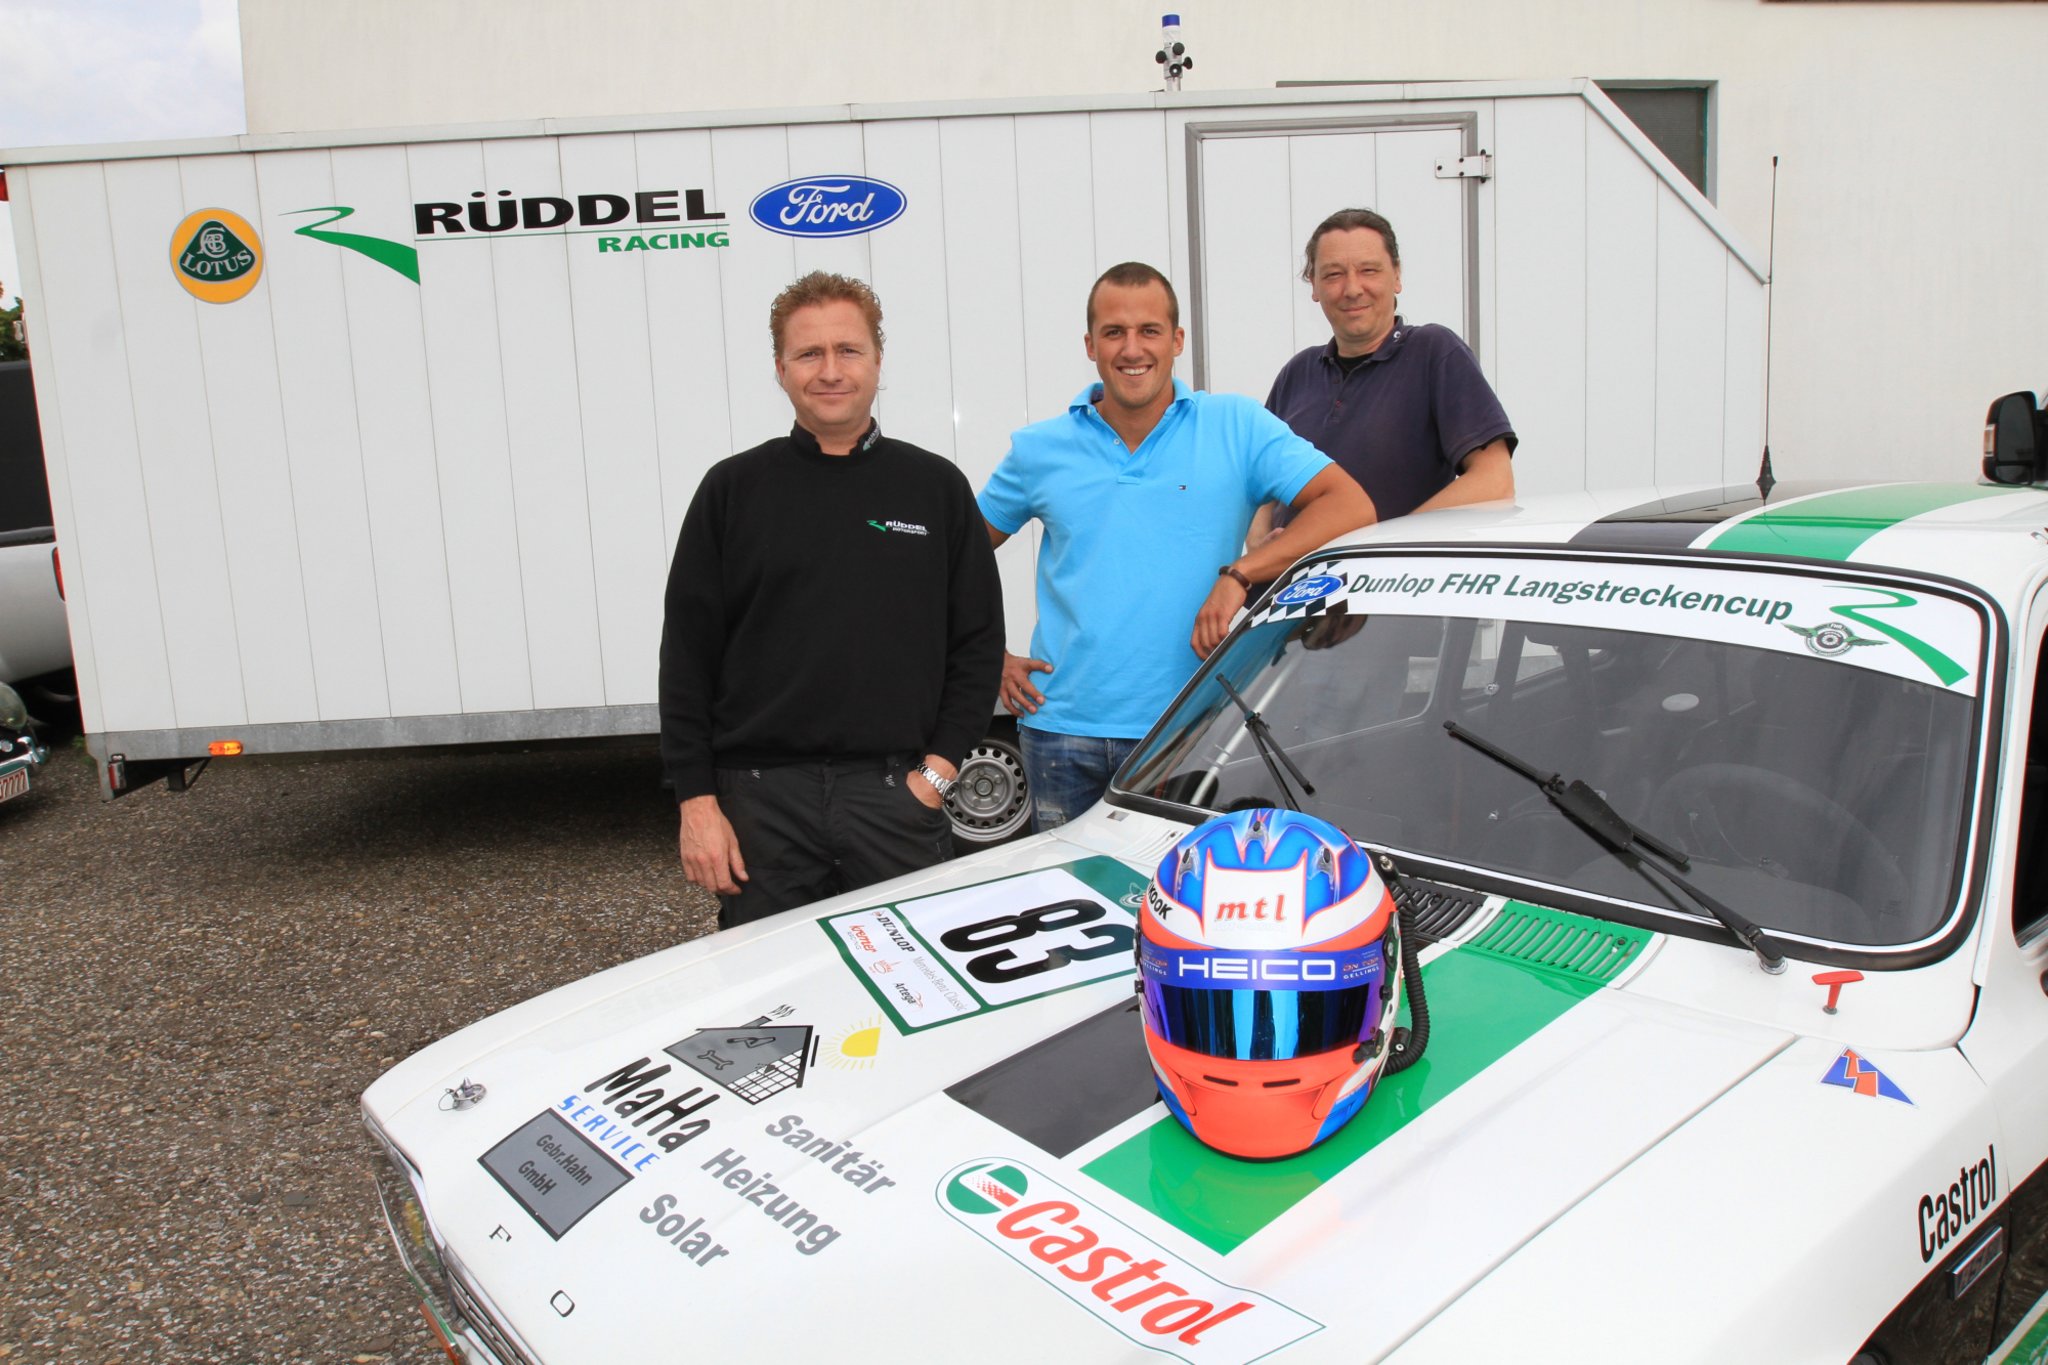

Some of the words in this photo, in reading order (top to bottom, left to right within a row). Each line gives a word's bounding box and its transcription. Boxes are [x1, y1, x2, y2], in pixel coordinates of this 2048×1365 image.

[414, 190, 726, 235] RÜDDEL
[780, 185, 875, 226] Ford
[182, 249, 252, 276] LOTUS
[598, 232, 730, 253] RACING
[1284, 579, 1330, 601] Ford
[1349, 573, 1435, 597] Dunlop
[1439, 573, 1501, 596] FHR
[1503, 574, 1793, 625] Langstreckencup
[1215, 894, 1286, 922] mtl
[876, 916, 916, 953] DUNLOP
[940, 899, 1138, 984] 83
[1178, 956, 1336, 981] HEICO
[893, 982, 917, 1005] Artega
[584, 1057, 721, 1154] MaHa
[557, 1094, 660, 1172] SERVICE
[765, 1114, 897, 1195] Sanitär
[517, 1160, 558, 1197] GmbH
[701, 1147, 842, 1256] Heizung
[1918, 1144, 1996, 1264] Castrol
[489, 1224, 512, 1243] F
[639, 1193, 730, 1267] Solar
[996, 1200, 1256, 1347] Castrol
[549, 1289, 575, 1318] O
